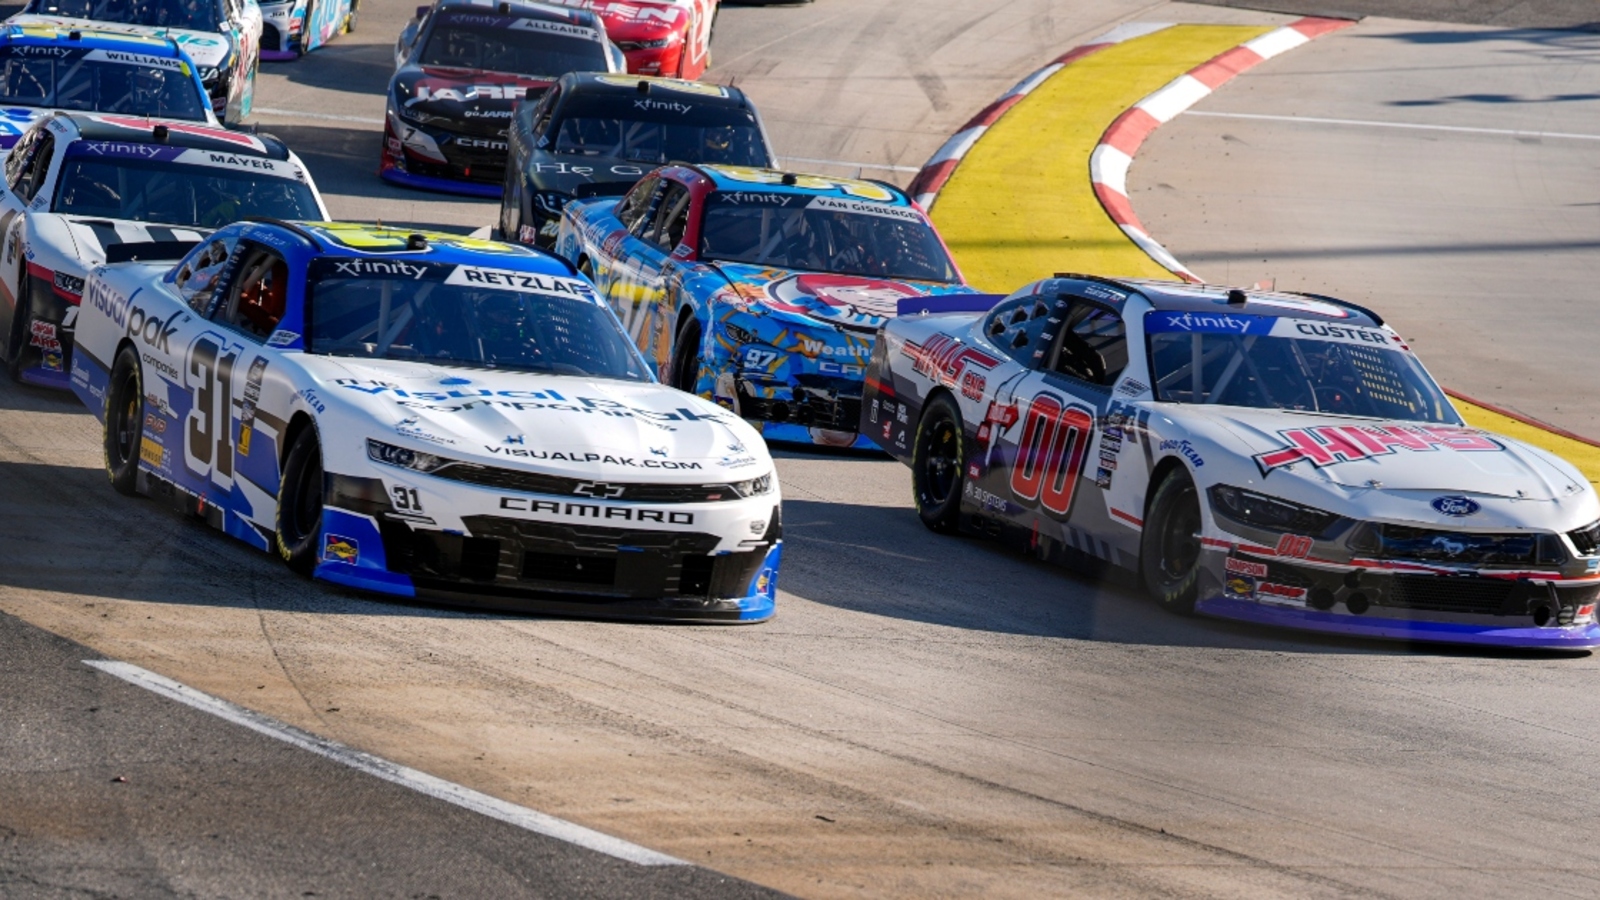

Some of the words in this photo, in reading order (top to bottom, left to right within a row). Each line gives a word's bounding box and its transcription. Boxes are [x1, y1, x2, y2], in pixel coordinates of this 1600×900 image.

[449, 13, 501, 26] xfinity
[525, 21, 589, 37] ALLGAIER
[11, 45, 73, 58] xfinity
[634, 99, 693, 114] xfinity
[403, 127, 416, 141] 7
[86, 142, 162, 157] xfinity
[210, 153, 275, 172] MAYER
[721, 191, 792, 207] xfinity
[817, 199, 848, 209] VAN
[335, 258, 428, 279] xfinity
[1167, 313, 1252, 333] xfinity
[1296, 322, 1388, 345] CUSTER
[744, 348, 777, 370] 97
[185, 335, 237, 492] 31
[484, 445, 703, 470] VISUALPAK.COM
[1010, 392, 1093, 515] 00
[391, 485, 422, 513] 31
[982, 490, 1007, 512] SYSTEMS
[1441, 498, 1470, 513] Ford
[500, 496, 694, 525] CAMARO
[1276, 534, 1312, 558] 00
[1226, 558, 1266, 576] SIMPSON
